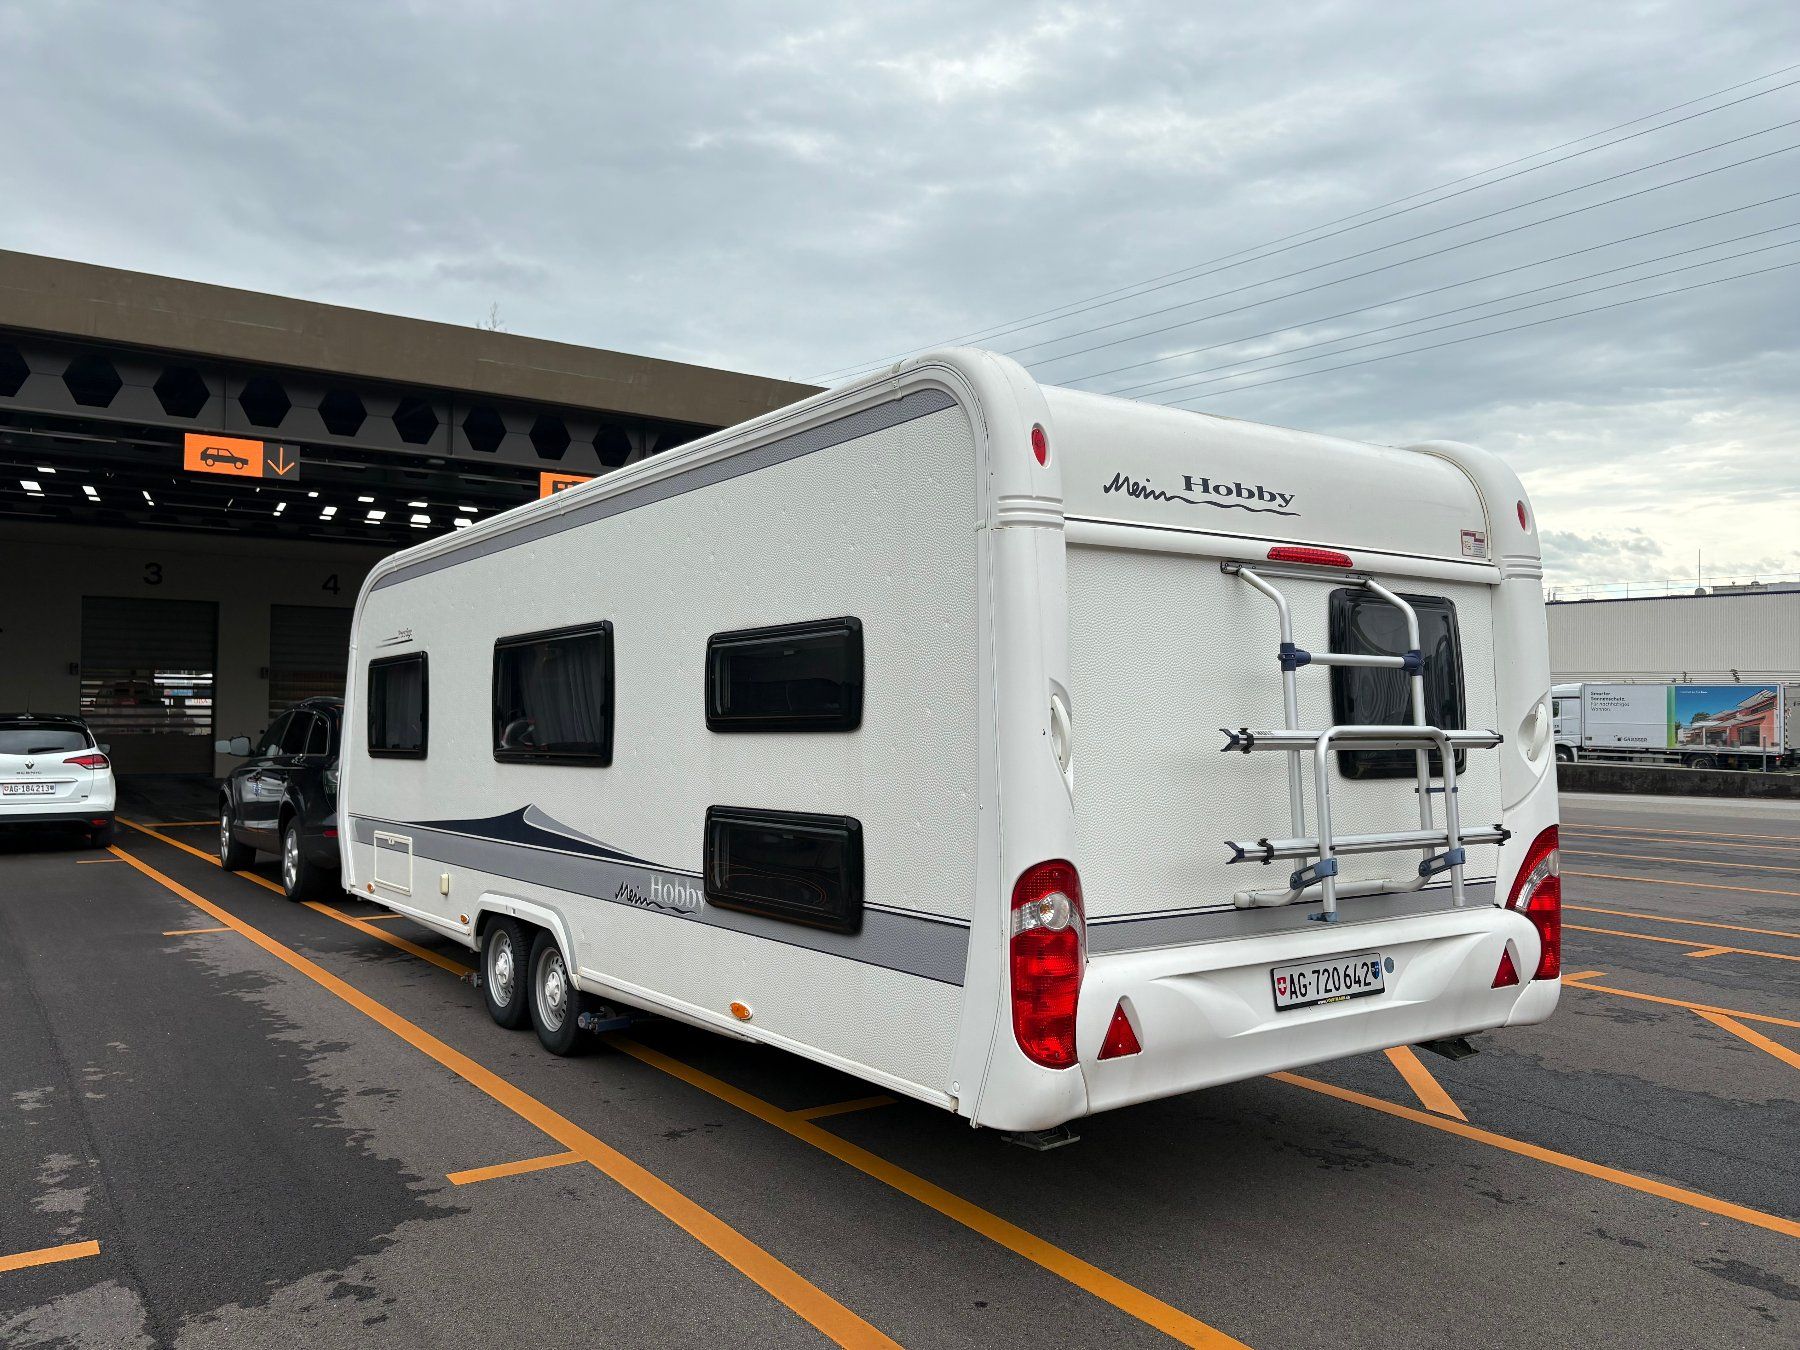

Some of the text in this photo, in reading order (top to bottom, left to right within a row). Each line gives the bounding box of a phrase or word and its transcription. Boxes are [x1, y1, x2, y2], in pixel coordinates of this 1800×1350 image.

[1103, 472, 1295, 508] Mein Hobby
[143, 562, 163, 586] 3
[321, 574, 341, 595] 4
[615, 873, 705, 915] Mein Hobby
